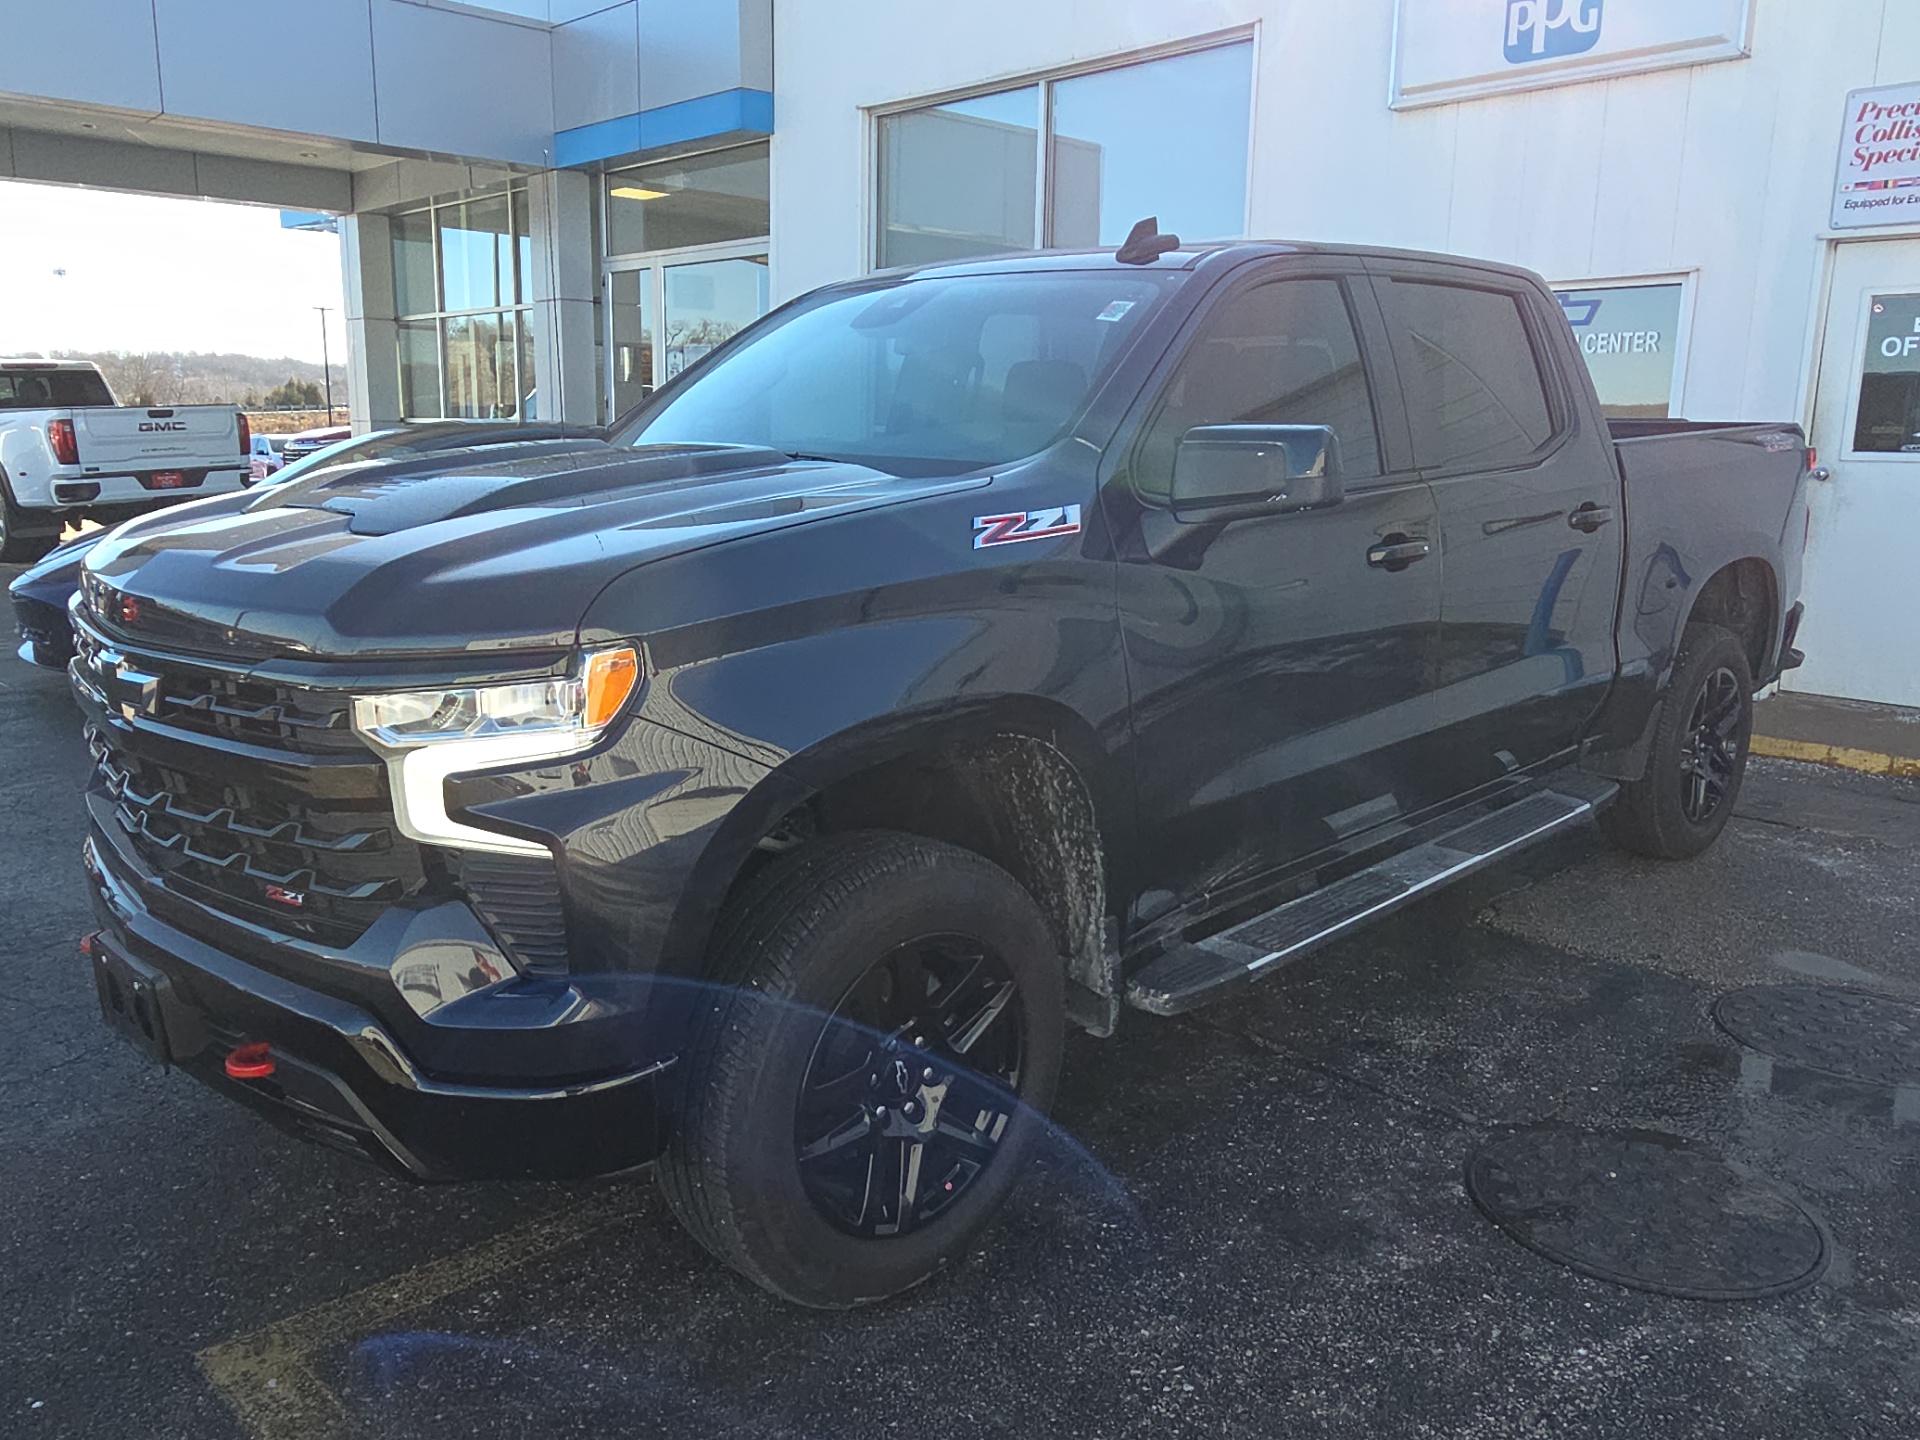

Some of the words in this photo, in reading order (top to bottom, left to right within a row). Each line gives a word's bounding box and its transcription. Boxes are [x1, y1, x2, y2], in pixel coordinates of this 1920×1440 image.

[1844, 196, 1890, 210] Equipped
[1891, 195, 1905, 205] for
[1584, 331, 1660, 354] CENTER
[138, 422, 187, 432] GMC
[973, 504, 1081, 550] Z71
